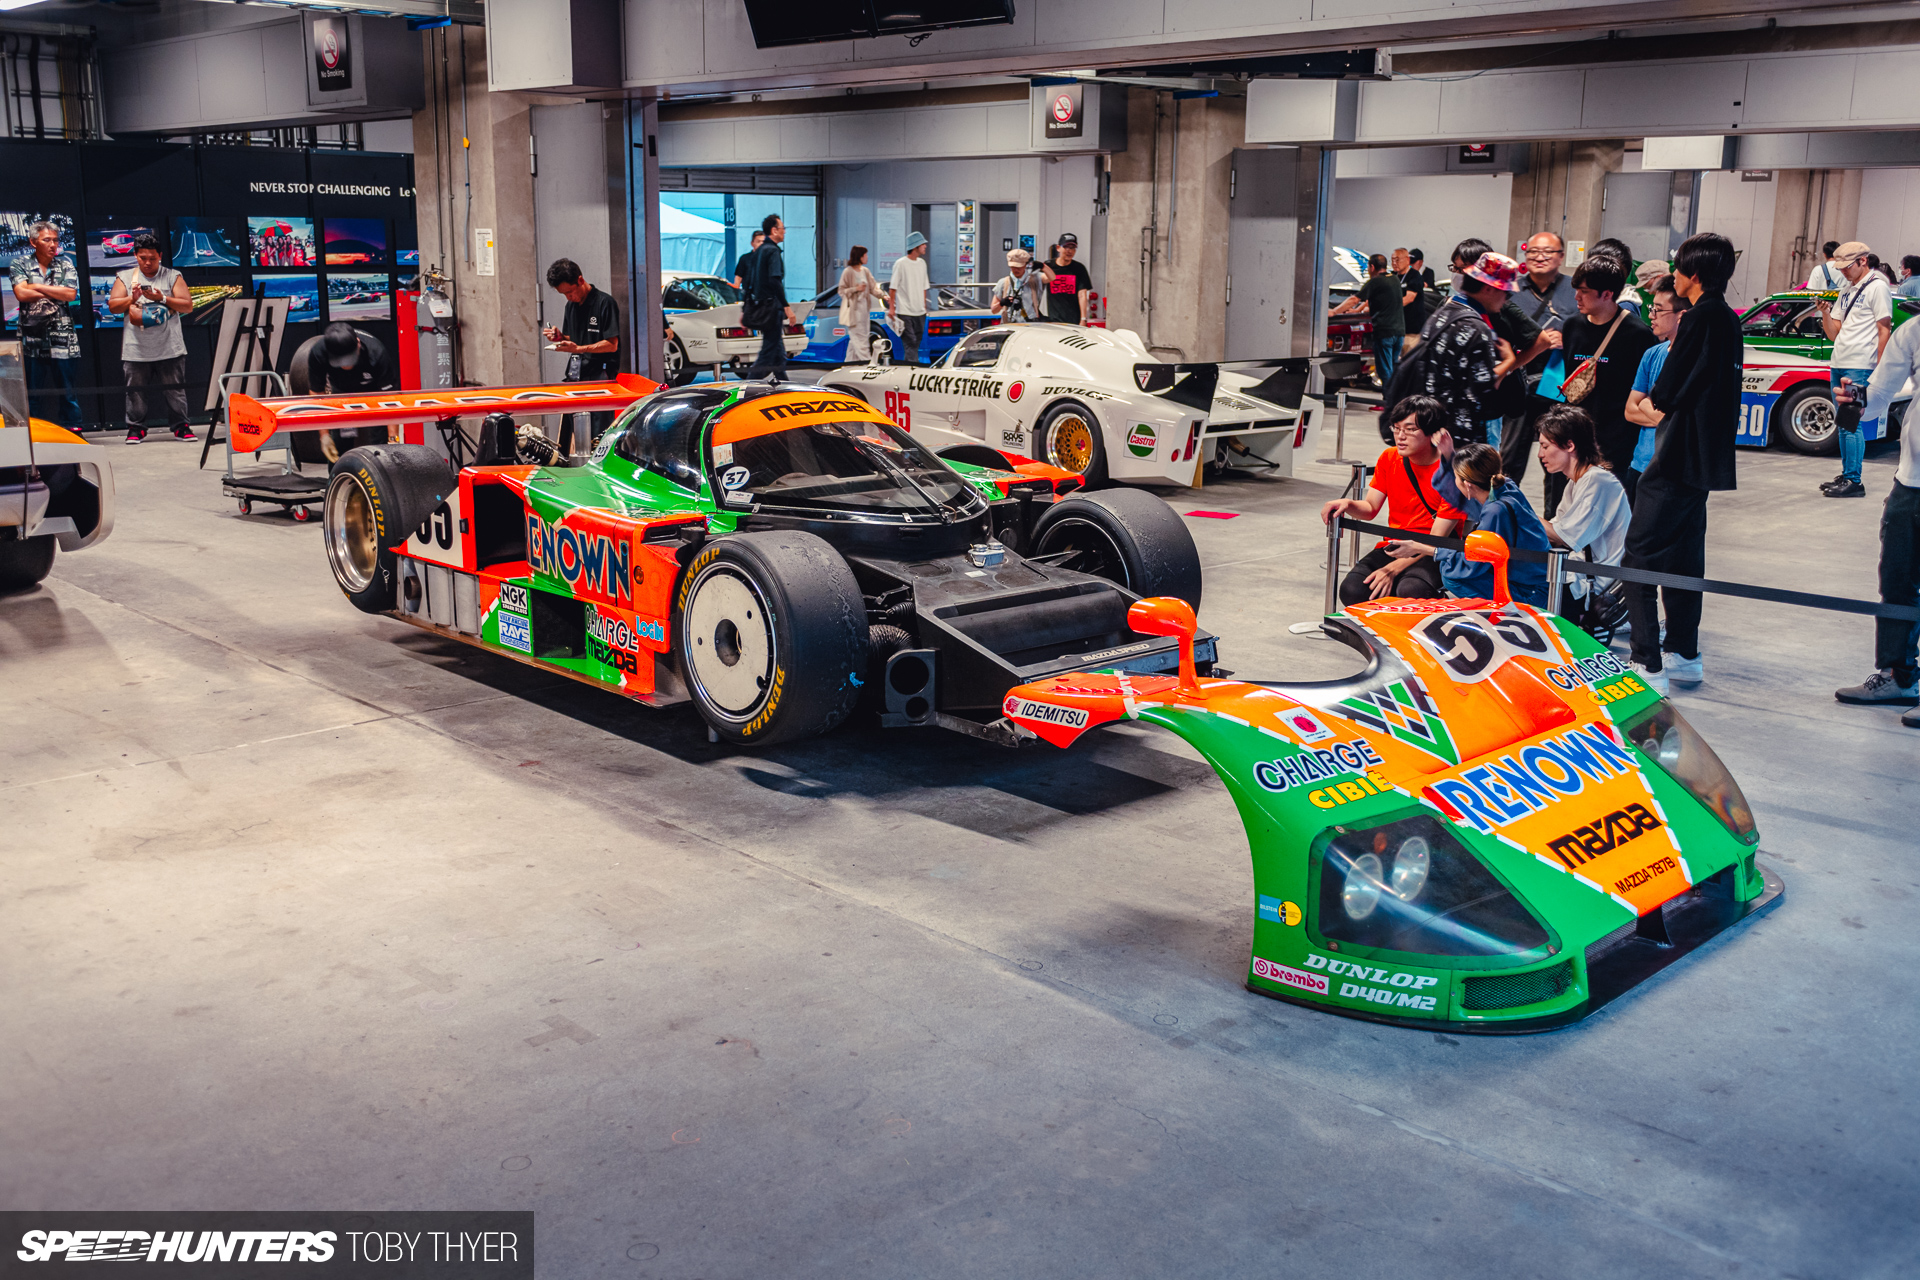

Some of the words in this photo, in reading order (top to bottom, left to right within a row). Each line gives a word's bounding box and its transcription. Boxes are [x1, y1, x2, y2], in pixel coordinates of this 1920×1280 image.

[1057, 122, 1077, 130] Smoking
[250, 182, 286, 193] NEVER
[288, 183, 315, 194] STOP
[317, 184, 391, 197] CHALLENGING
[400, 187, 411, 197] Le
[725, 207, 735, 222] 18
[909, 373, 955, 394] LUCKY
[952, 377, 1003, 399] STRIKE
[759, 400, 871, 422] mazda
[885, 390, 911, 433] 85
[238, 423, 260, 436] mazda
[1003, 432, 1024, 443] RAYS
[1130, 434, 1156, 447] Castrol
[726, 471, 747, 486] 37
[358, 468, 385, 537] DUNLOP
[525, 512, 631, 601] ENOWN
[679, 547, 720, 613] DUNLOP
[502, 585, 527, 608] NGK
[500, 622, 530, 642] RAYS
[585, 604, 639, 652] CHARGE
[588, 635, 637, 675] mazda
[1081, 643, 1150, 661] MAZDASPEED
[1422, 611, 1548, 676] 55
[1545, 650, 1631, 691] CHARGE
[743, 664, 785, 736] DUNLOP
[1021, 702, 1086, 727] IDEMITSU
[1253, 737, 1385, 793] CHARGE
[1430, 722, 1641, 835] RENOWN
[1546, 802, 1663, 870] mazda
[1614, 867, 1652, 895] MAZDA
[1648, 856, 1676, 877] 787B
[1270, 964, 1326, 990] brembo
[1303, 953, 1438, 990] DUNLOP
[1339, 982, 1437, 1011] D40/M2
